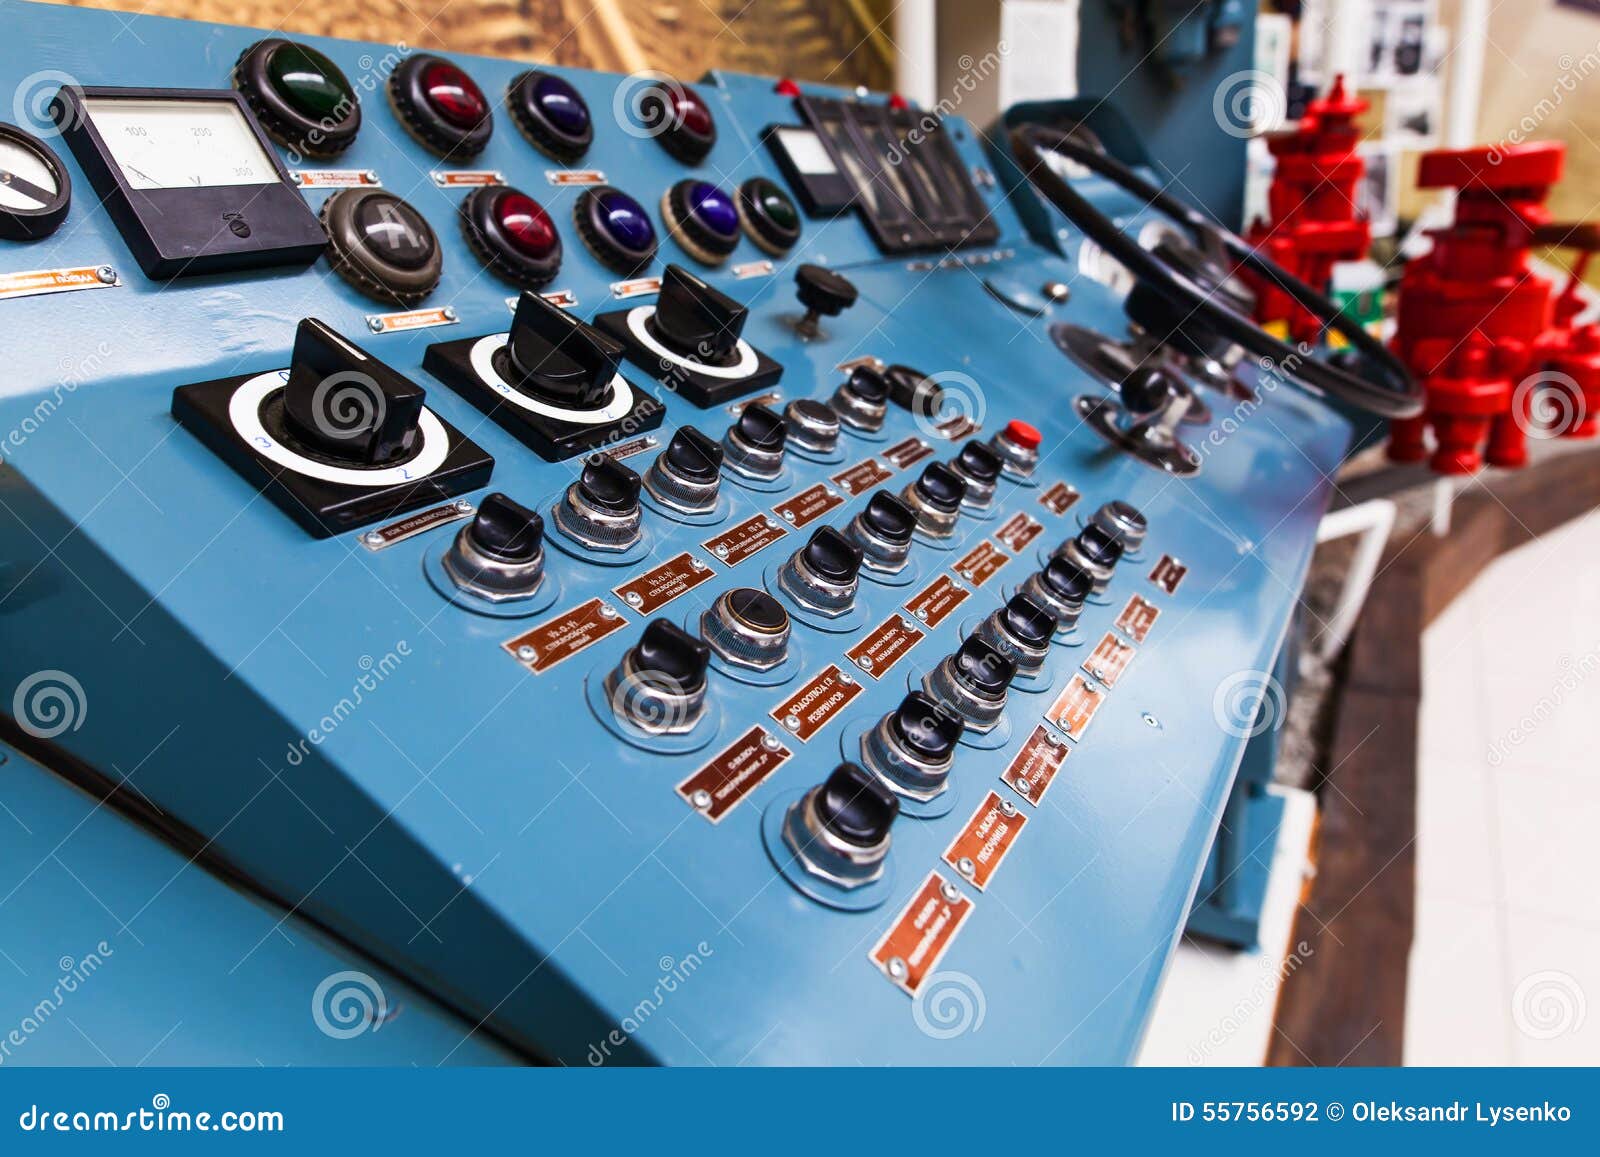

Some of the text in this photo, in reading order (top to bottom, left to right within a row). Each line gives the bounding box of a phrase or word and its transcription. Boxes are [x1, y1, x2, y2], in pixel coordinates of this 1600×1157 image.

[125, 126, 147, 136] 100
[190, 127, 212, 137] 200
[789, 684, 829, 715] ВОДООТВОД
[807, 691, 845, 724] РЕЗЕРВУАРОВ
